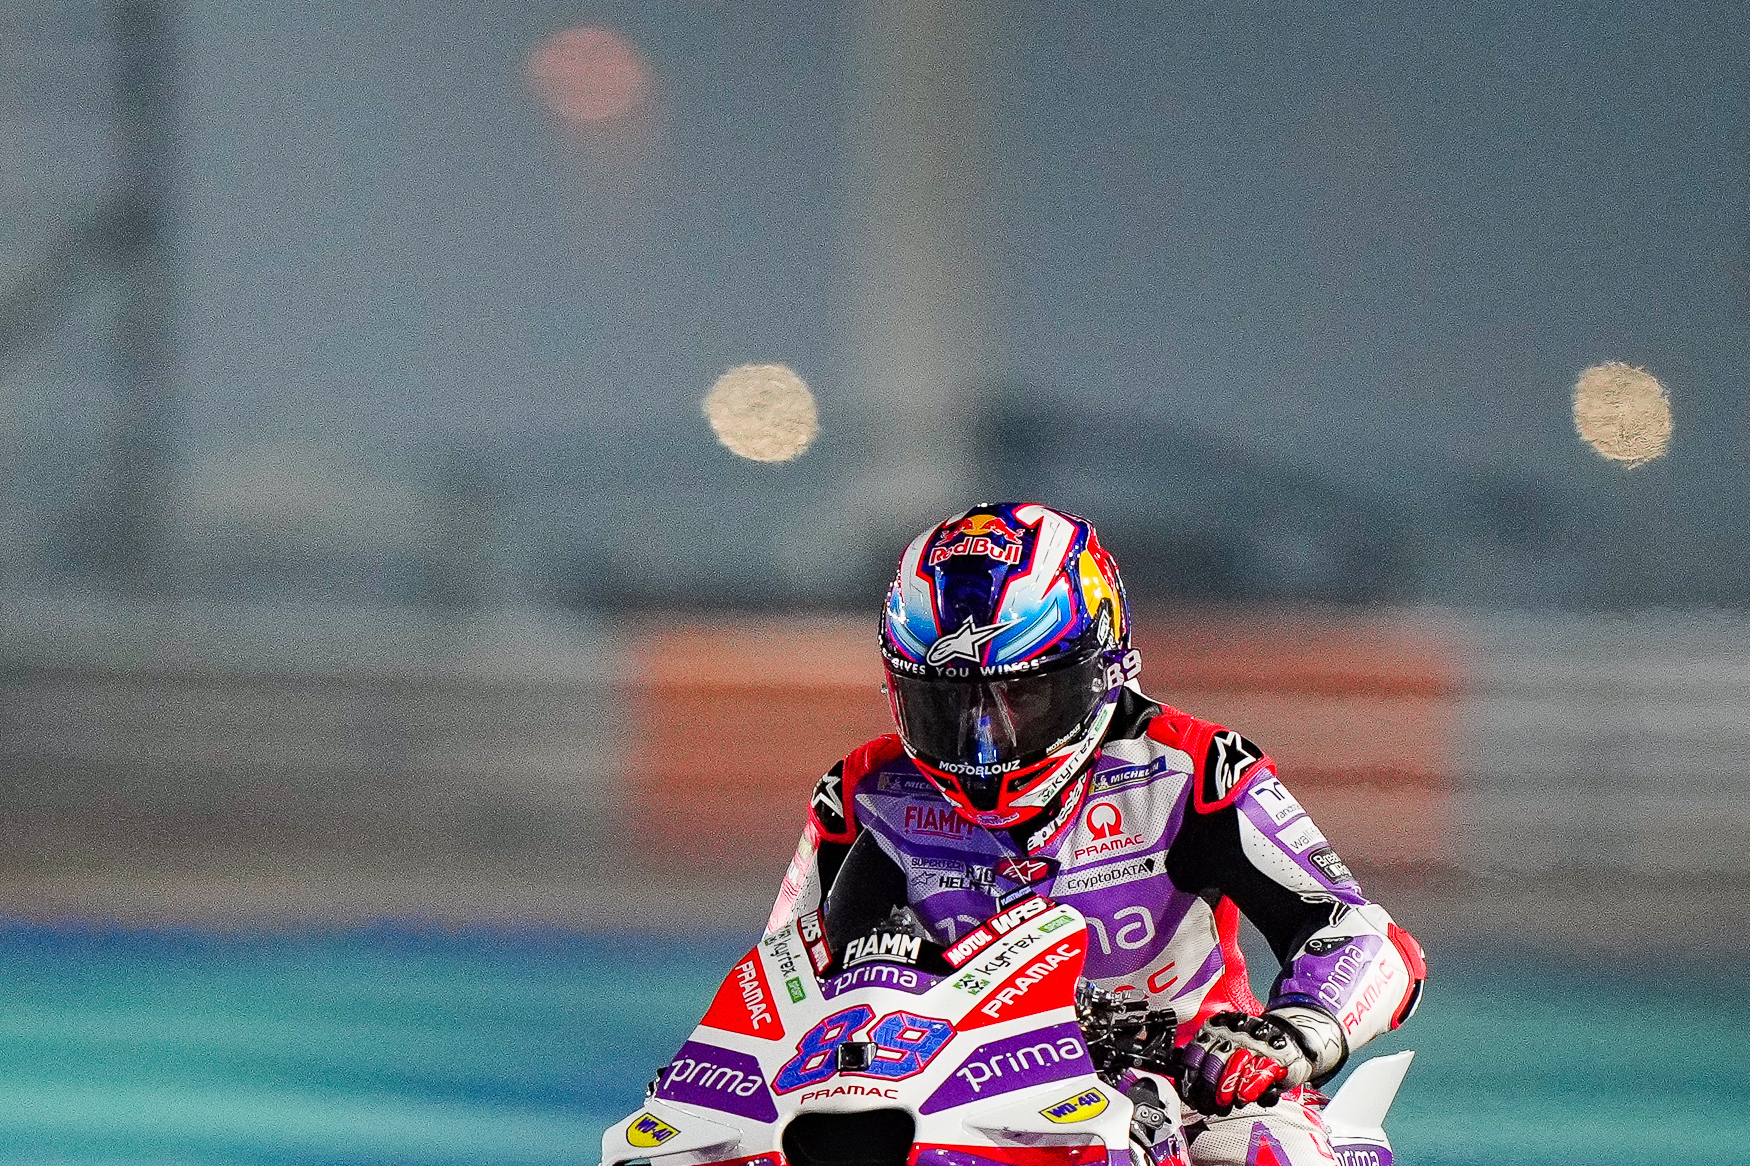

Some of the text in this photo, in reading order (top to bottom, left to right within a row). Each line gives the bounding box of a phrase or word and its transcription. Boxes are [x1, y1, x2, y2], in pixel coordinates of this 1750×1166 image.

[928, 536, 1023, 566] Red Bull
[892, 656, 1041, 678] GIVES YOU WINGS
[939, 760, 1021, 778] MOTOBLOUZ
[1110, 761, 1160, 784] MICHELIN
[1073, 833, 1145, 861] PRAMAC
[1067, 862, 1148, 890] CryptoDATA
[842, 931, 922, 964] FIAMM
[947, 929, 993, 966] MOTUL
[833, 965, 919, 996] prima
[980, 942, 1082, 1019] PRAMAC
[1318, 944, 1365, 1009] prima
[735, 960, 773, 1030] PRAMAC
[1343, 959, 1395, 1035] RAMAC
[770, 1003, 959, 1096] 89
[956, 1036, 1085, 1093] prima
[670, 1058, 763, 1097] prima
[800, 1085, 899, 1105] PRAMAC
[1049, 1091, 1101, 1119] WD-40
